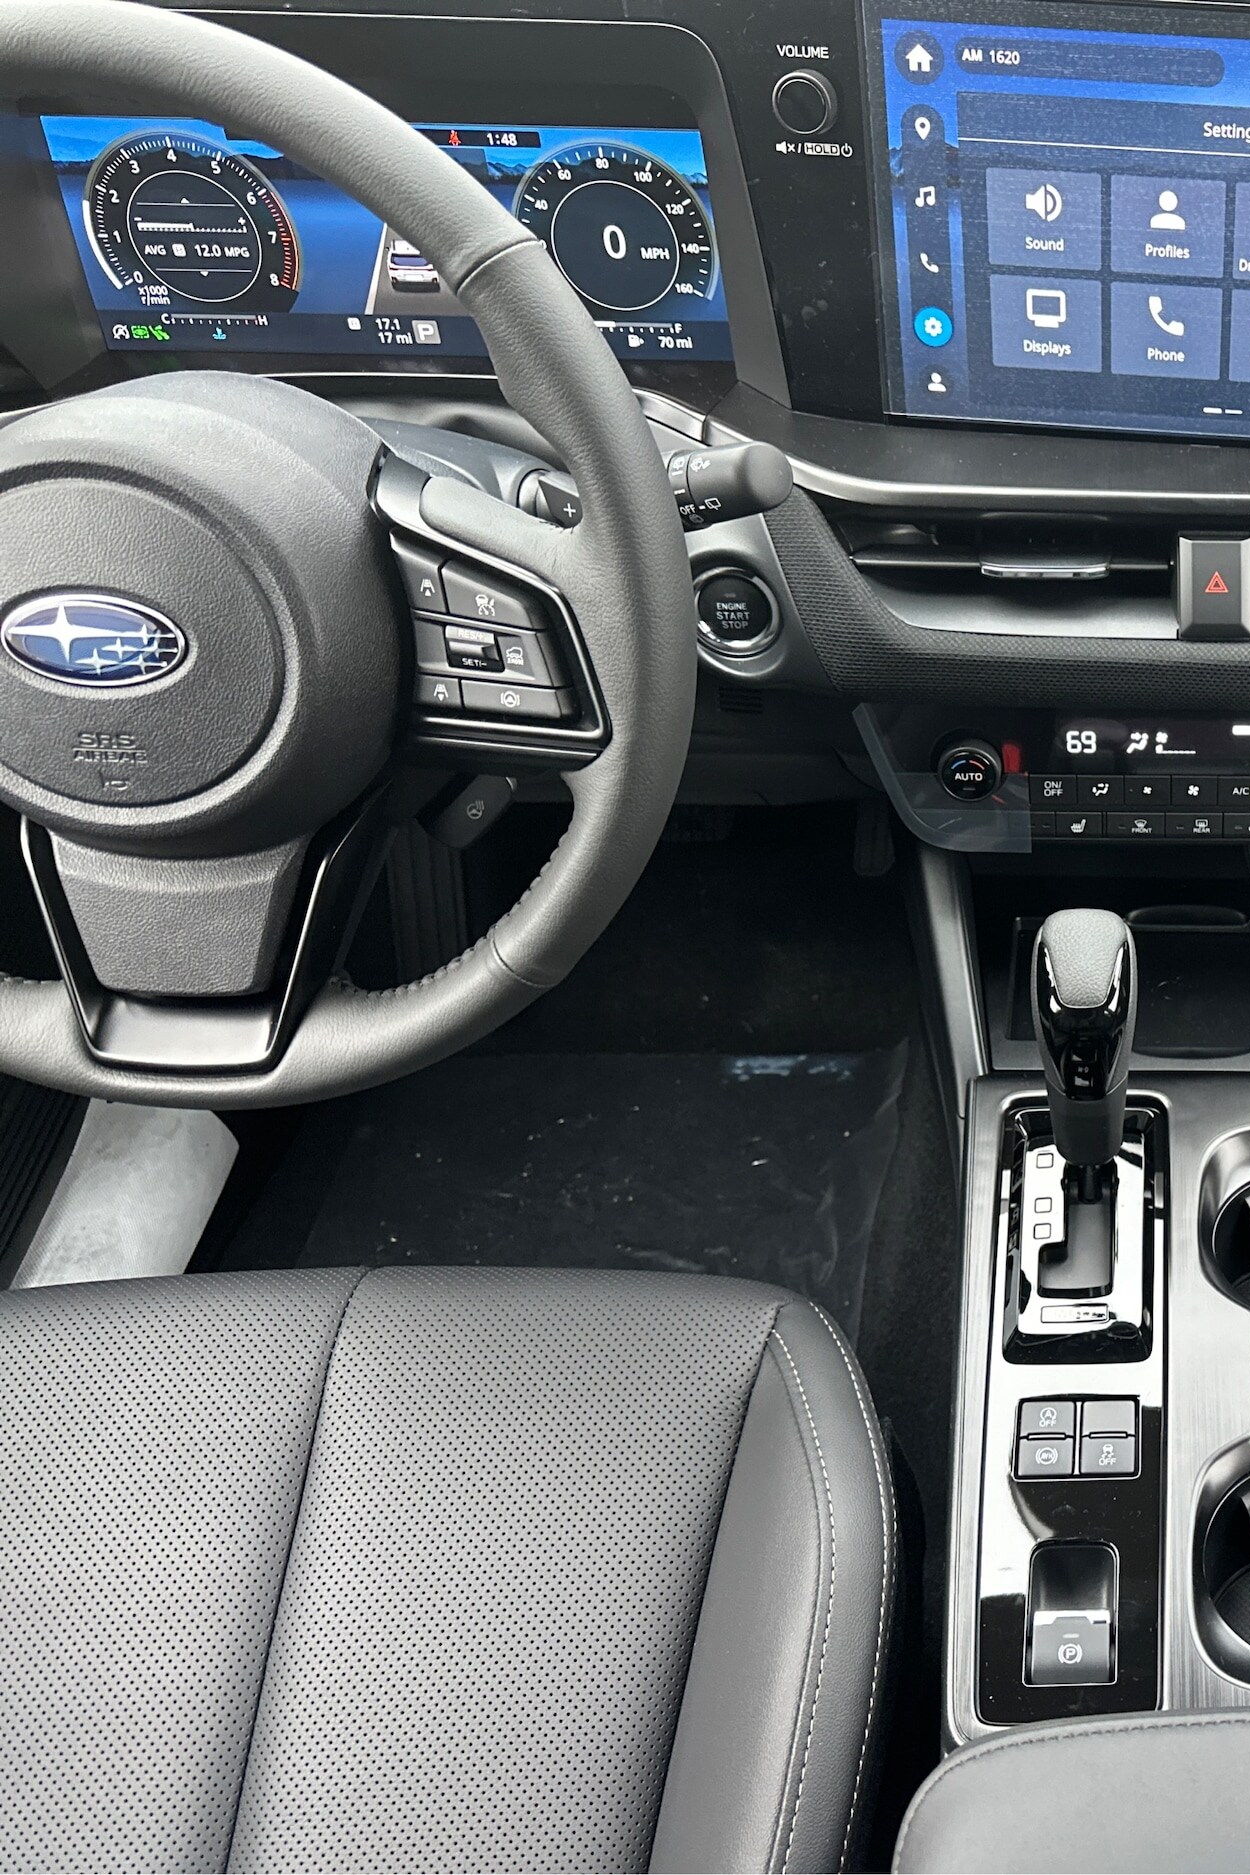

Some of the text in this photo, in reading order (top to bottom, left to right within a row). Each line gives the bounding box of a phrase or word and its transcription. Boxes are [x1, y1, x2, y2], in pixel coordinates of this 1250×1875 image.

[776, 45, 829, 59] VOLUME
[962, 49, 1020, 64] AM 1620
[486, 132, 517, 146] 1:48
[805, 144, 839, 155] HOLD
[166, 149, 177, 163] 4
[130, 161, 140, 173] 3
[211, 161, 221, 174] 5
[595, 158, 609, 170] 80
[557, 169, 572, 182] 60
[633, 171, 652, 183] 100
[110, 190, 120, 203] 2
[246, 193, 257, 205] 6
[534, 199, 548, 210] 40
[665, 203, 684, 216] 120
[113, 230, 121, 243] 1
[268, 232, 277, 244] 7
[602, 224, 670, 261] 0 MPH
[681, 242, 699, 254] 140
[1025, 237, 1064, 251] Sound
[145, 244, 250, 258] AVG 12.0 MPG
[1145, 244, 1190, 259] Profiles
[133, 271, 143, 284] 0
[269, 273, 279, 286] 8
[674, 283, 693, 295] 160
[141, 294, 171, 306] r/min
[161, 313, 170, 324] C
[258, 315, 268, 326] H
[375, 318, 400, 330] 17.1
[417, 324, 434, 341] P
[674, 323, 683, 334] F
[378, 332, 413, 345] 17 mi
[658, 336, 693, 349] 70 mi
[1023, 340, 1072, 356] Displays
[1147, 348, 1185, 362] Phone
[679, 504, 696, 515] OFF
[716, 602, 747, 610] ENGINE
[716, 612, 750, 620] START
[722, 621, 749, 629] STOP
[78, 732, 136, 749] SRS
[1066, 731, 1096, 753] 69
[954, 772, 983, 781] AUTO
[1044, 781, 1062, 790] ON/
[1232, 786, 1249, 796] A/C
[1043, 788, 1063, 797] OFF
[1039, 1420, 1056, 1428] OFF
[1098, 1457, 1117, 1466] OFF
